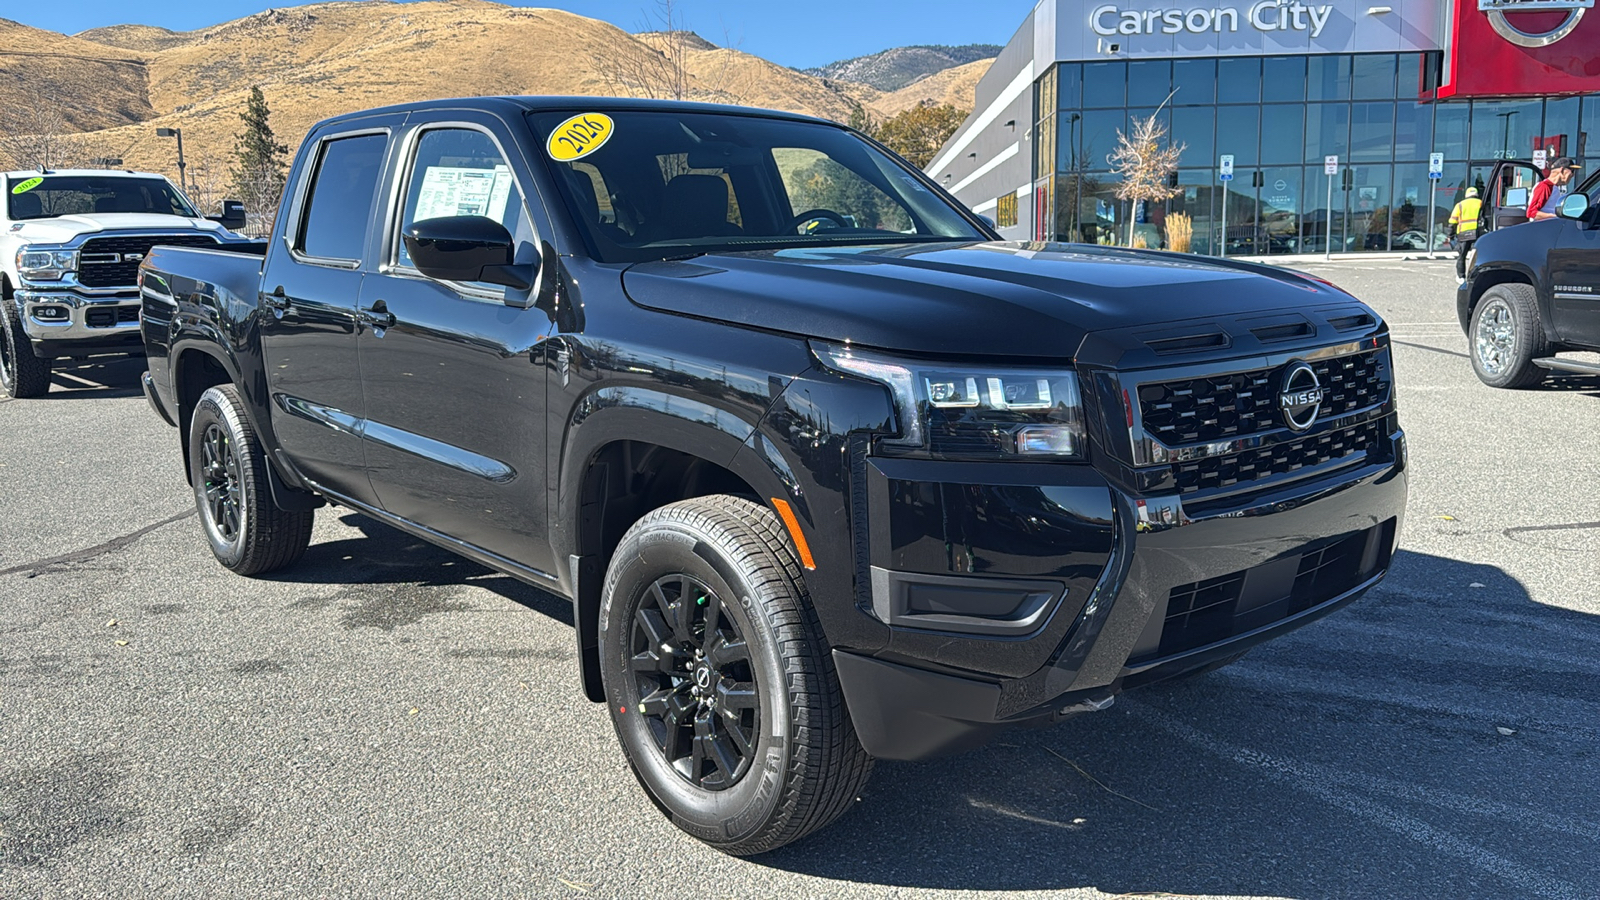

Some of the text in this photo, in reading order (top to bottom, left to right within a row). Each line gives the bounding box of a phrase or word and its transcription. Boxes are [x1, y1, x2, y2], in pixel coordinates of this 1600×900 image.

[1090, 1, 1333, 38] Carson City
[558, 116, 605, 154] 2026
[1493, 150, 1517, 159] 2750
[17, 178, 37, 191] 2024
[1282, 391, 1322, 406] NISSA
[644, 533, 678, 544] PRIMACY
